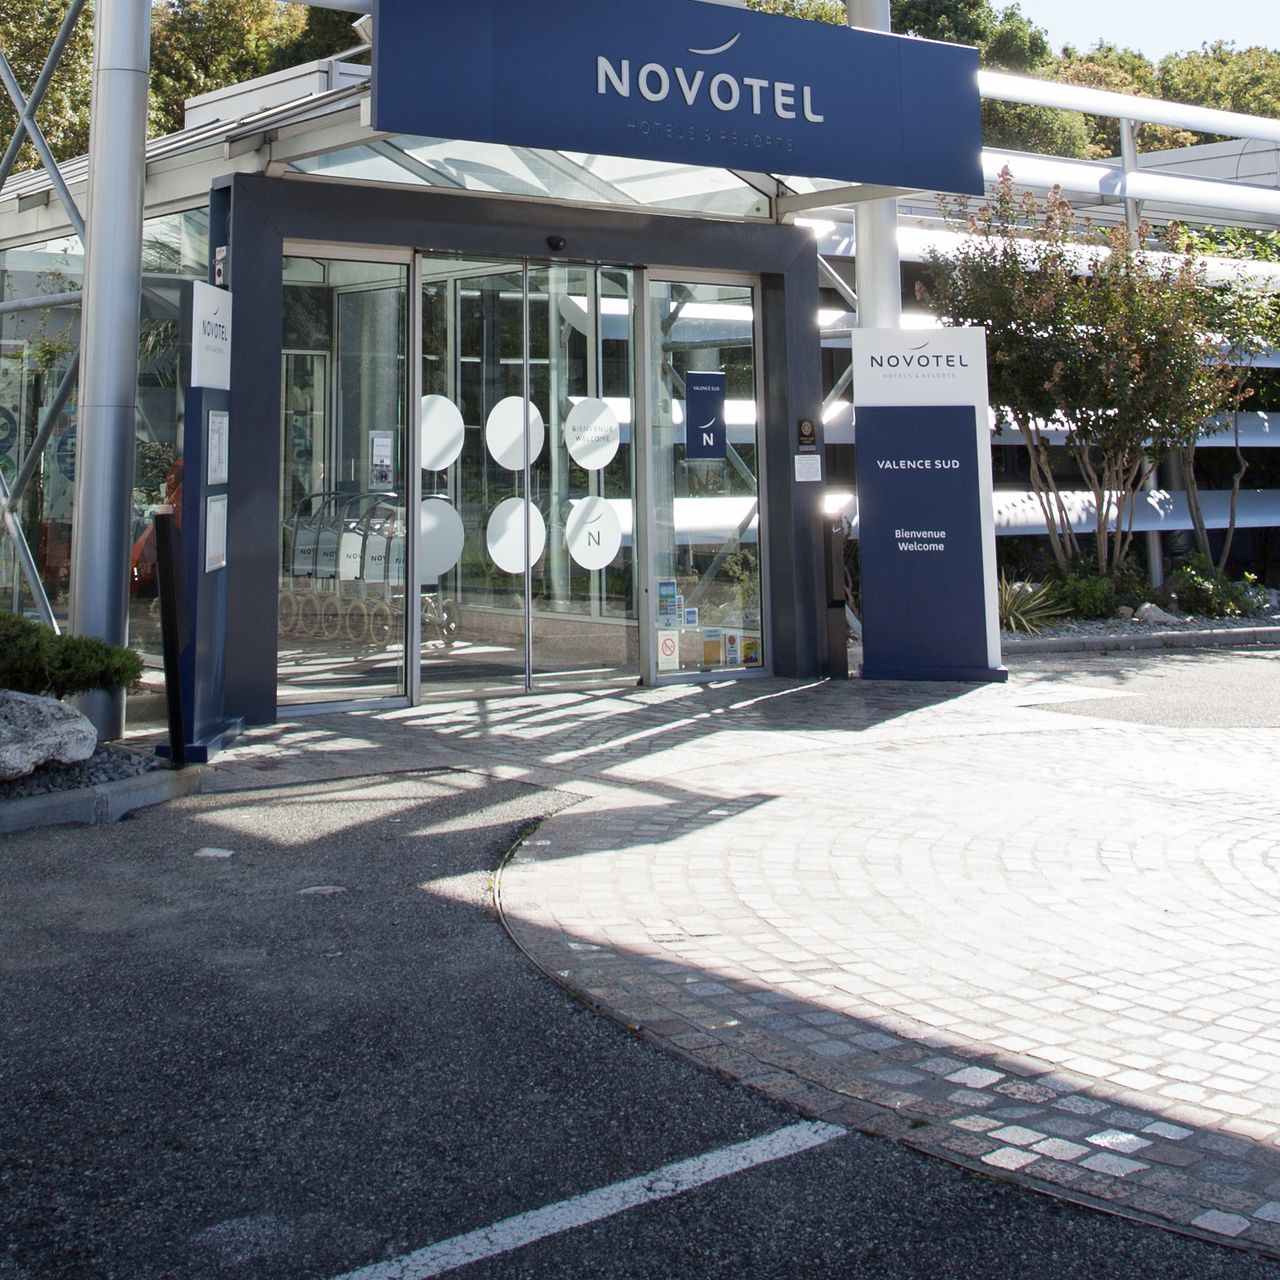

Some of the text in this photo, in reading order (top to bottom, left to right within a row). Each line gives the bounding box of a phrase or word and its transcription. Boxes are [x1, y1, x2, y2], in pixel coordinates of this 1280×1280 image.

[597, 56, 824, 122] NOVOTEL
[626, 119, 695, 141] HOTELS
[720, 130, 793, 152] RESORTS
[202, 319, 228, 342] NOVOTEL
[870, 355, 968, 368] NOVOTEL
[571, 424, 613, 433] BIENVENUE
[575, 434, 610, 442] WELCOME
[703, 432, 714, 446] N
[877, 460, 960, 469] VALENCE SUD
[588, 531, 601, 546] N
[895, 528, 946, 538] Bienvenue
[898, 540, 945, 551] Welcome
